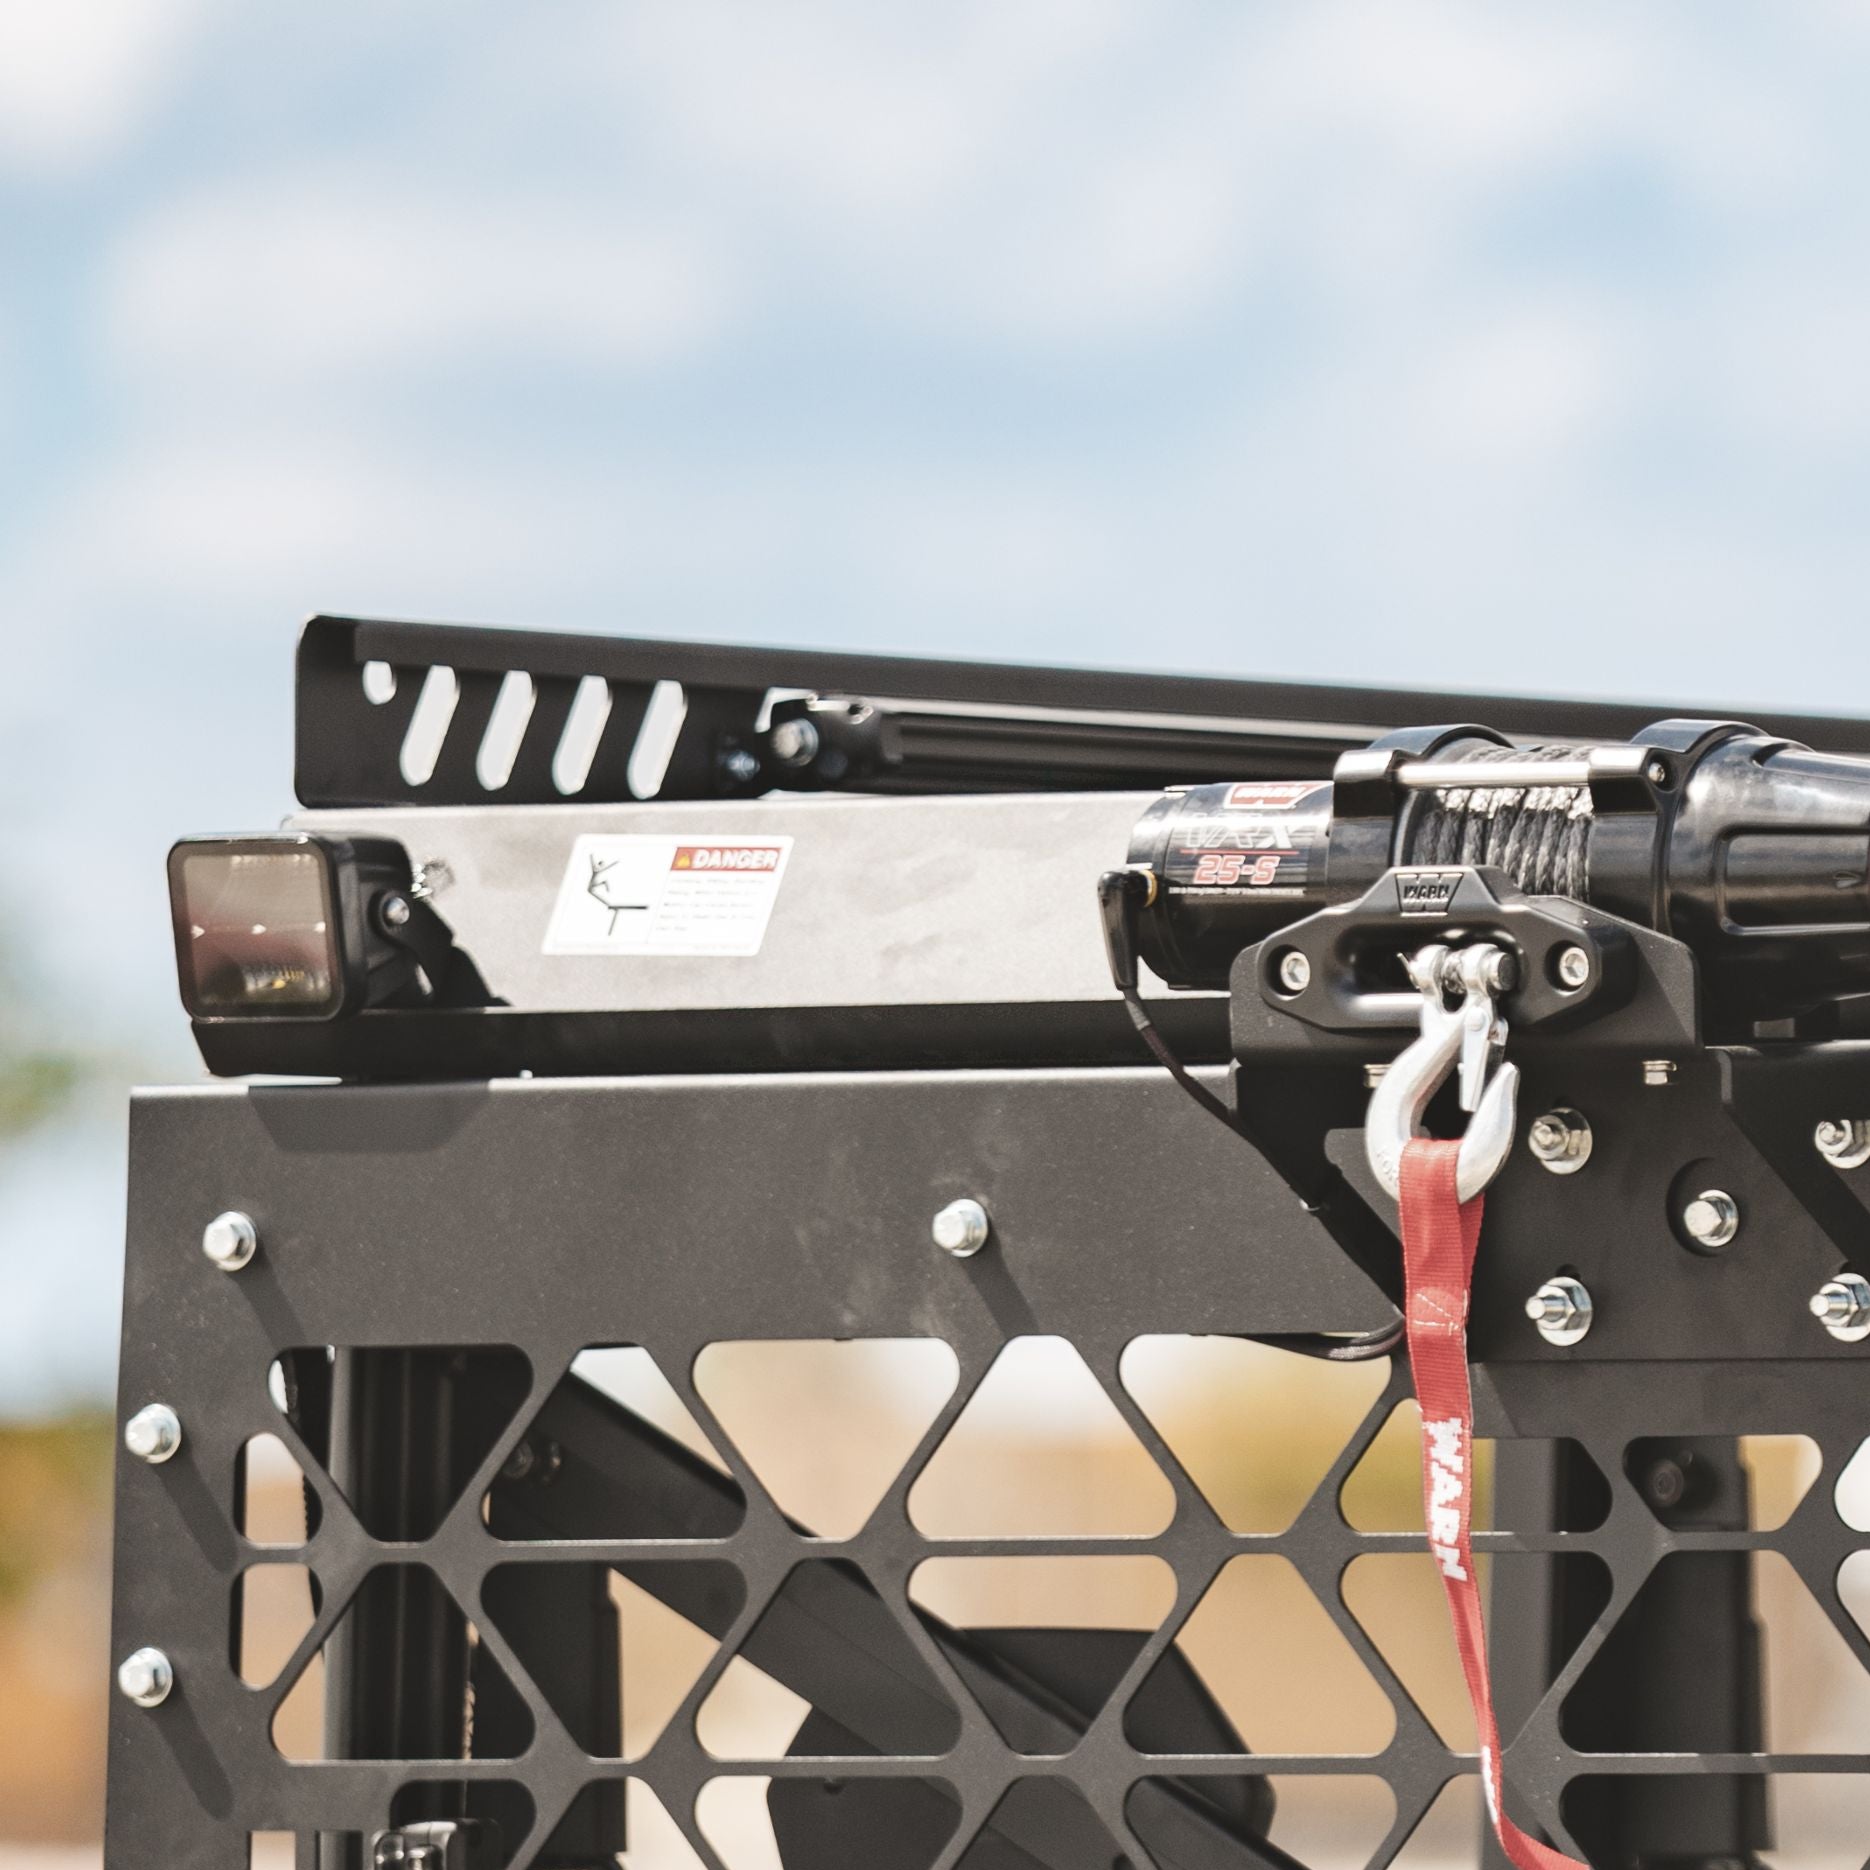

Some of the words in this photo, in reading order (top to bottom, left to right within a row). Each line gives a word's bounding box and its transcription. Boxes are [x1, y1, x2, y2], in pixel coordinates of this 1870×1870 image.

[692, 848, 780, 869] DANGER
[1192, 854, 1281, 885] 25-S
[1403, 884, 1449, 902] WARN
[1421, 1417, 1468, 1582] WARN
